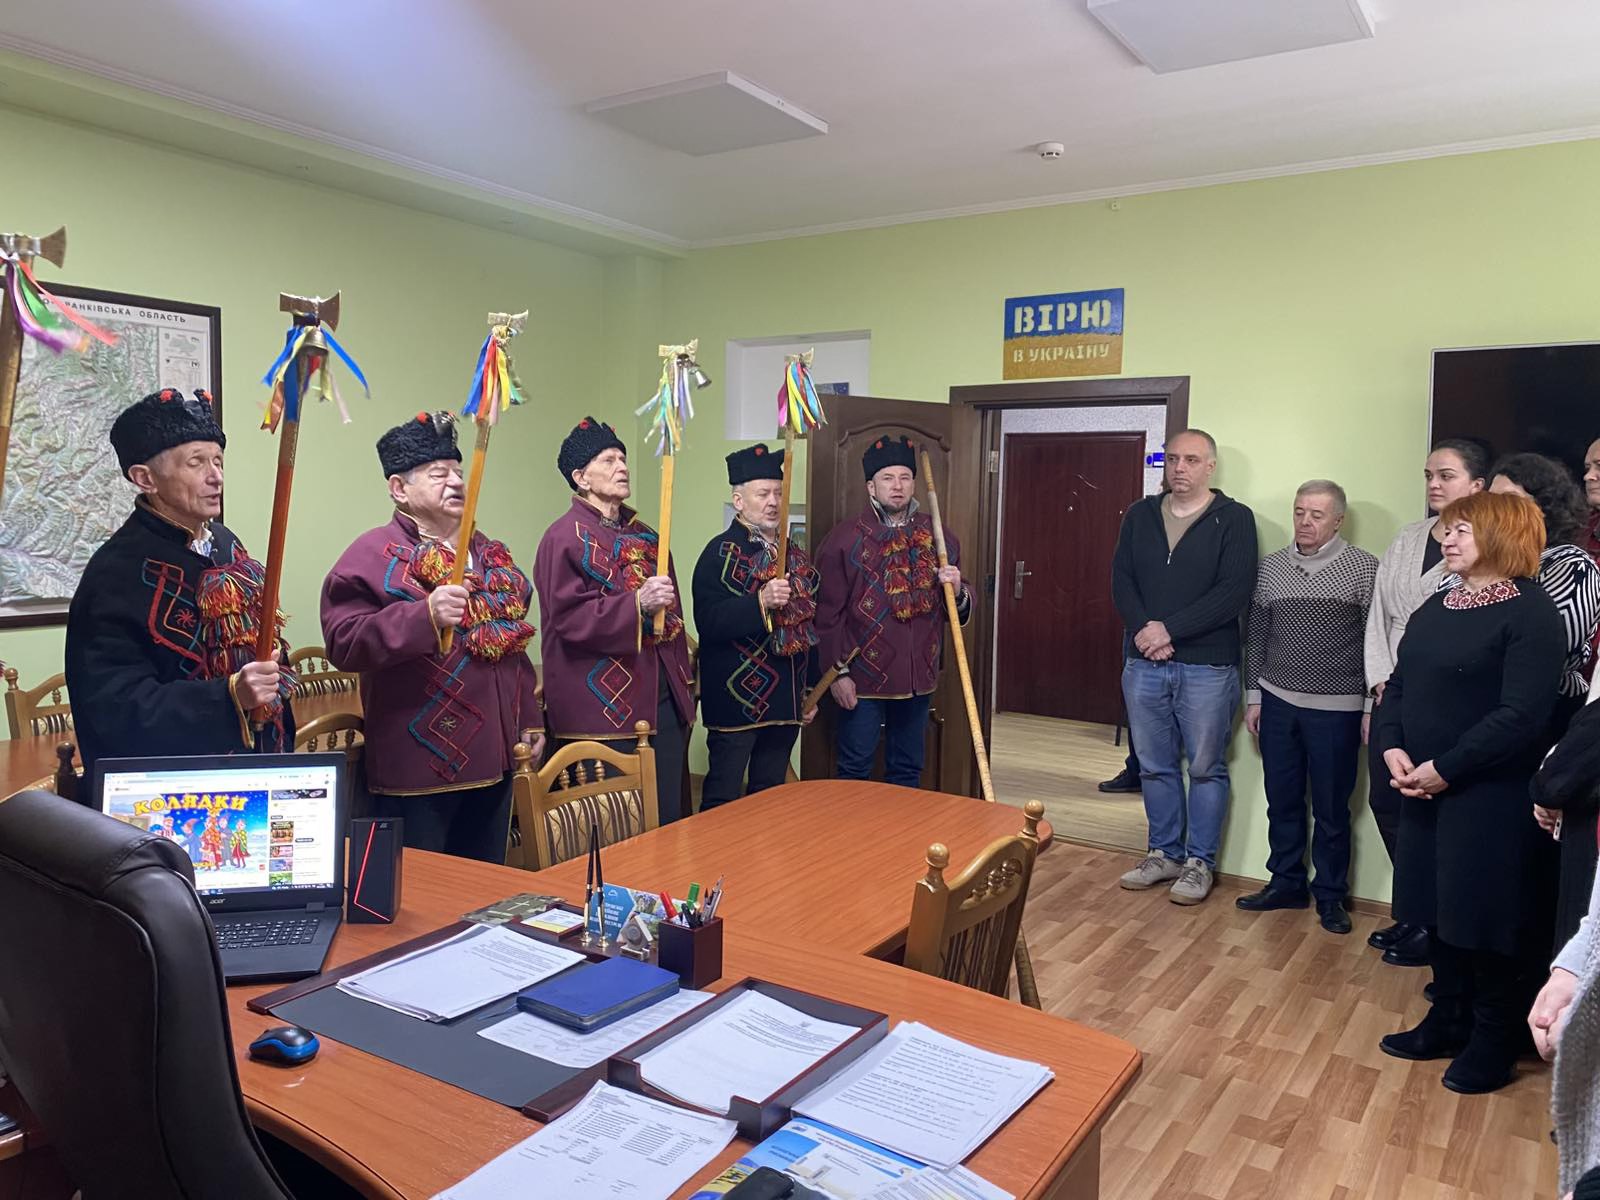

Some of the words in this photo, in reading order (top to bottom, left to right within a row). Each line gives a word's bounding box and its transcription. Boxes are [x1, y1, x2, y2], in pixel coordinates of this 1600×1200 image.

[139, 310, 186, 323] ОБЛАСТЬ
[1014, 299, 1111, 333] ВІРЮ
[1013, 349, 1024, 362] В
[1029, 342, 1110, 362] УКРАЇНУ
[133, 793, 249, 816] КОЛЯДКИ
